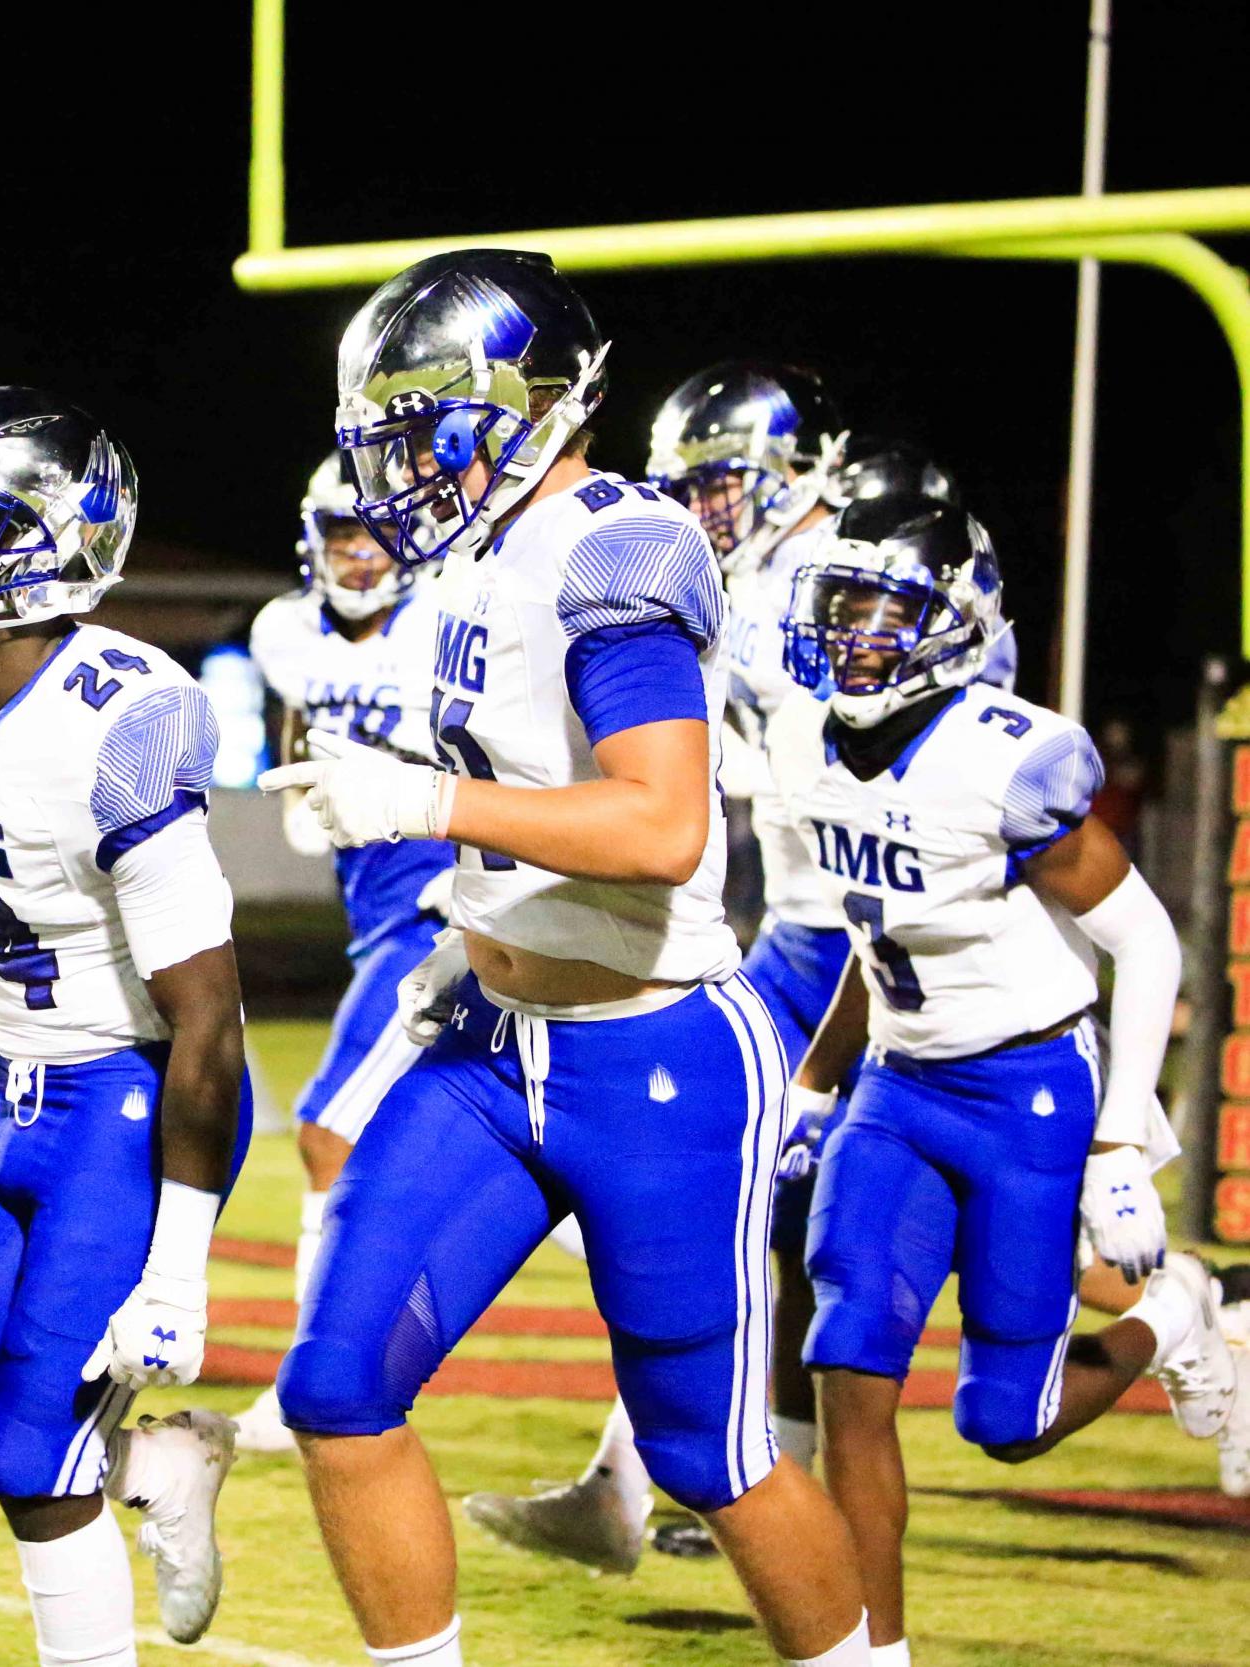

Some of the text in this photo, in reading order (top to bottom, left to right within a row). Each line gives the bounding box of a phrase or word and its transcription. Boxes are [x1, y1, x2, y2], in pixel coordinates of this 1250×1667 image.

[63, 648, 153, 712] 24
[978, 704, 1034, 740] 3
[812, 817, 926, 894] IMG
[843, 889, 927, 1013] 3
